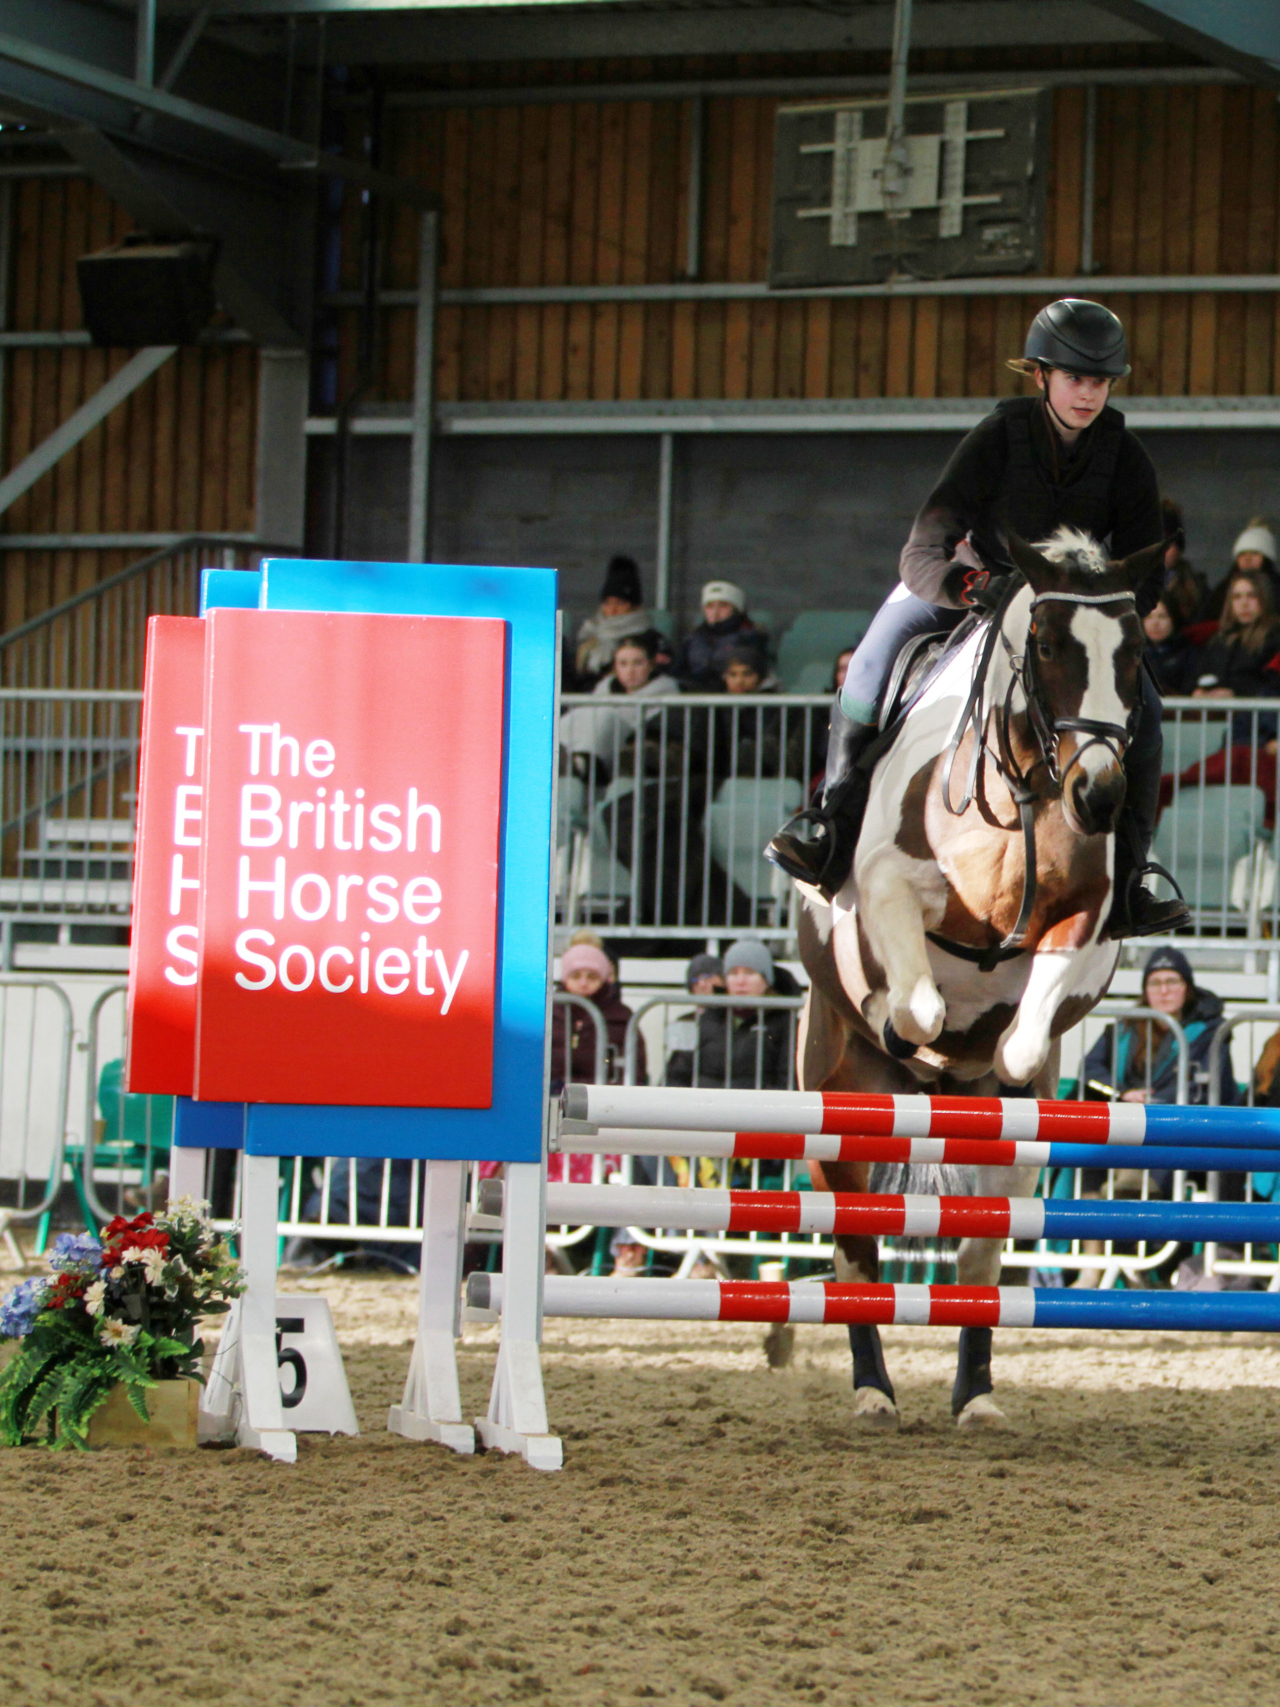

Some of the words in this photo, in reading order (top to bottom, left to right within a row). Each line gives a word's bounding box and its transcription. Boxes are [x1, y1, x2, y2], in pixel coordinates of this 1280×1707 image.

[238, 722, 336, 778] The
[240, 784, 442, 853] British
[237, 854, 442, 925] Horse
[234, 927, 470, 1016] Society
[275, 1317, 308, 1409] 5
